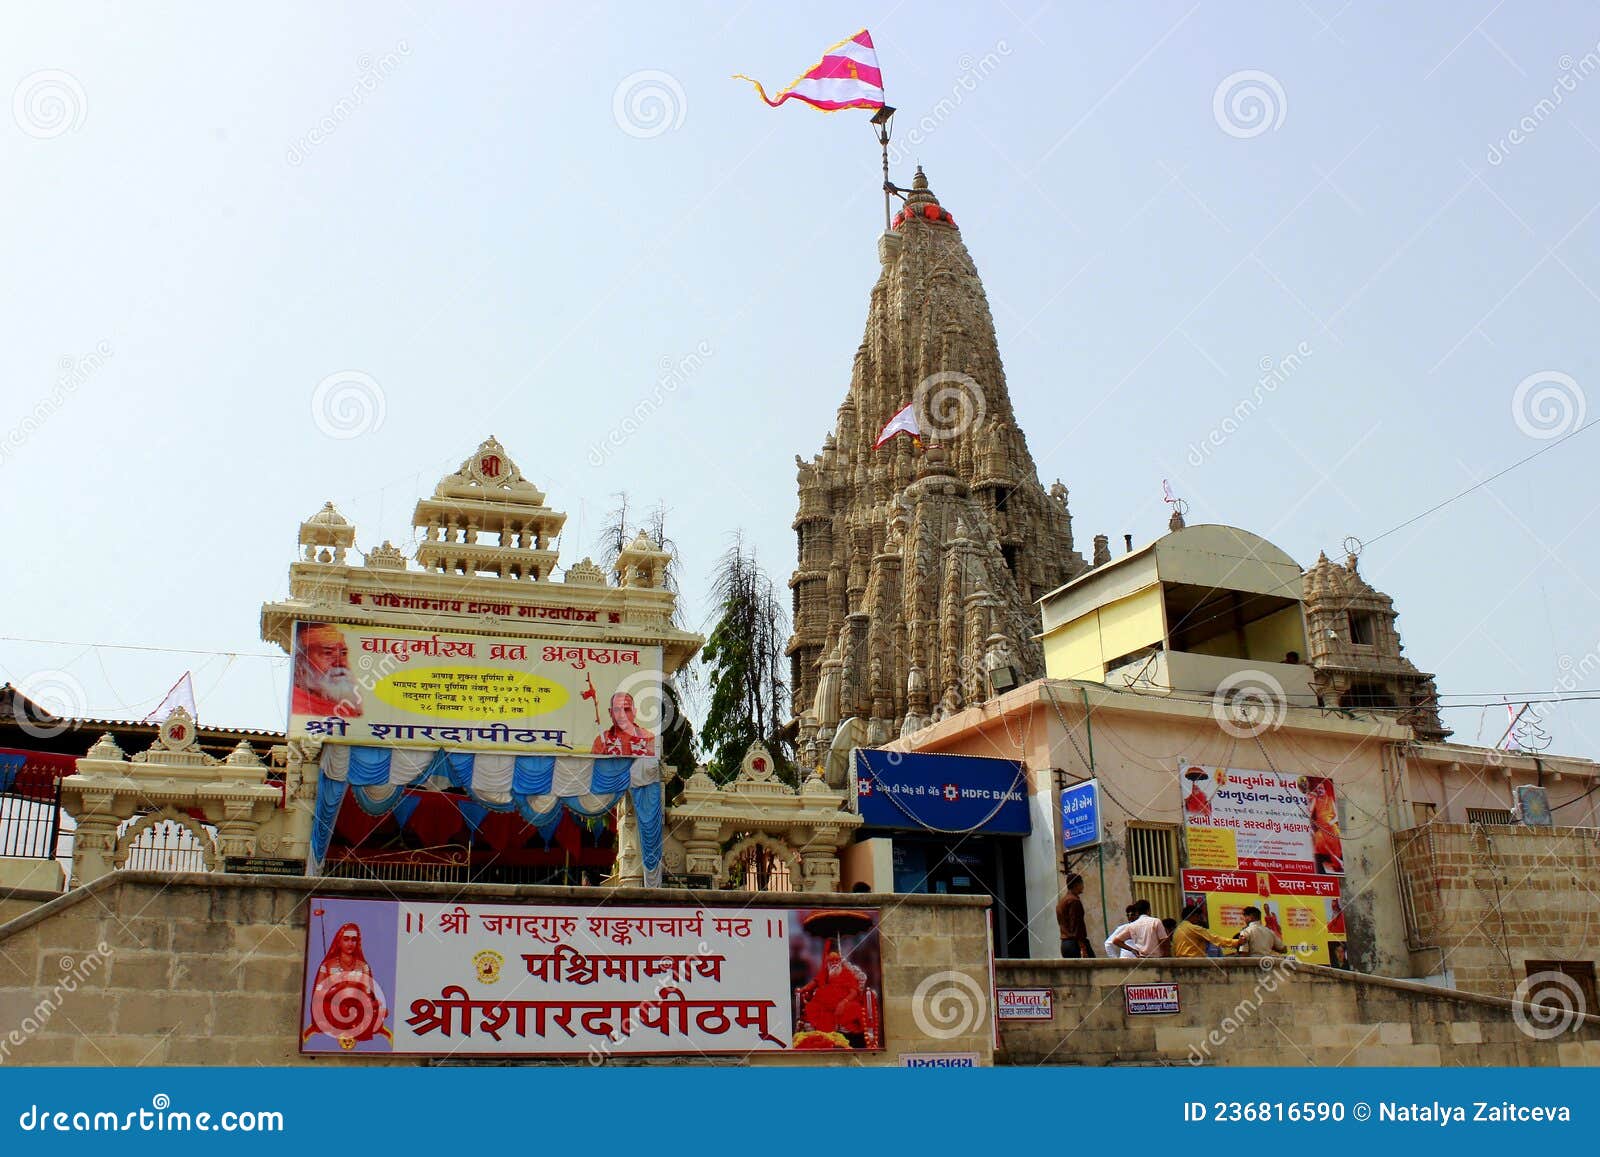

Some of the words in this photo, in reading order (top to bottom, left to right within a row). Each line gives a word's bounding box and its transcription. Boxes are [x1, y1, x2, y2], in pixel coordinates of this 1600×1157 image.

[360, 634, 477, 662] चातुर्मास्य
[488, 643, 528, 660] व्रत
[543, 645, 641, 670] अनुष्ठान
[305, 716, 350, 737] श्री
[368, 723, 574, 750] शारदापीठम्
[961, 789, 990, 799] HDFC
[993, 790, 1023, 801] BANK
[1277, 879, 1335, 895] व्यास-पूजा
[438, 906, 471, 935] श्री
[480, 914, 578, 945] जगद्गुरु
[712, 918, 753, 938] मठ
[521, 943, 727, 985] पश्चिमाम्नाय
[1128, 988, 1168, 1001] SHRIMATA
[405, 985, 788, 1049] श्रीशारदापीठम्
